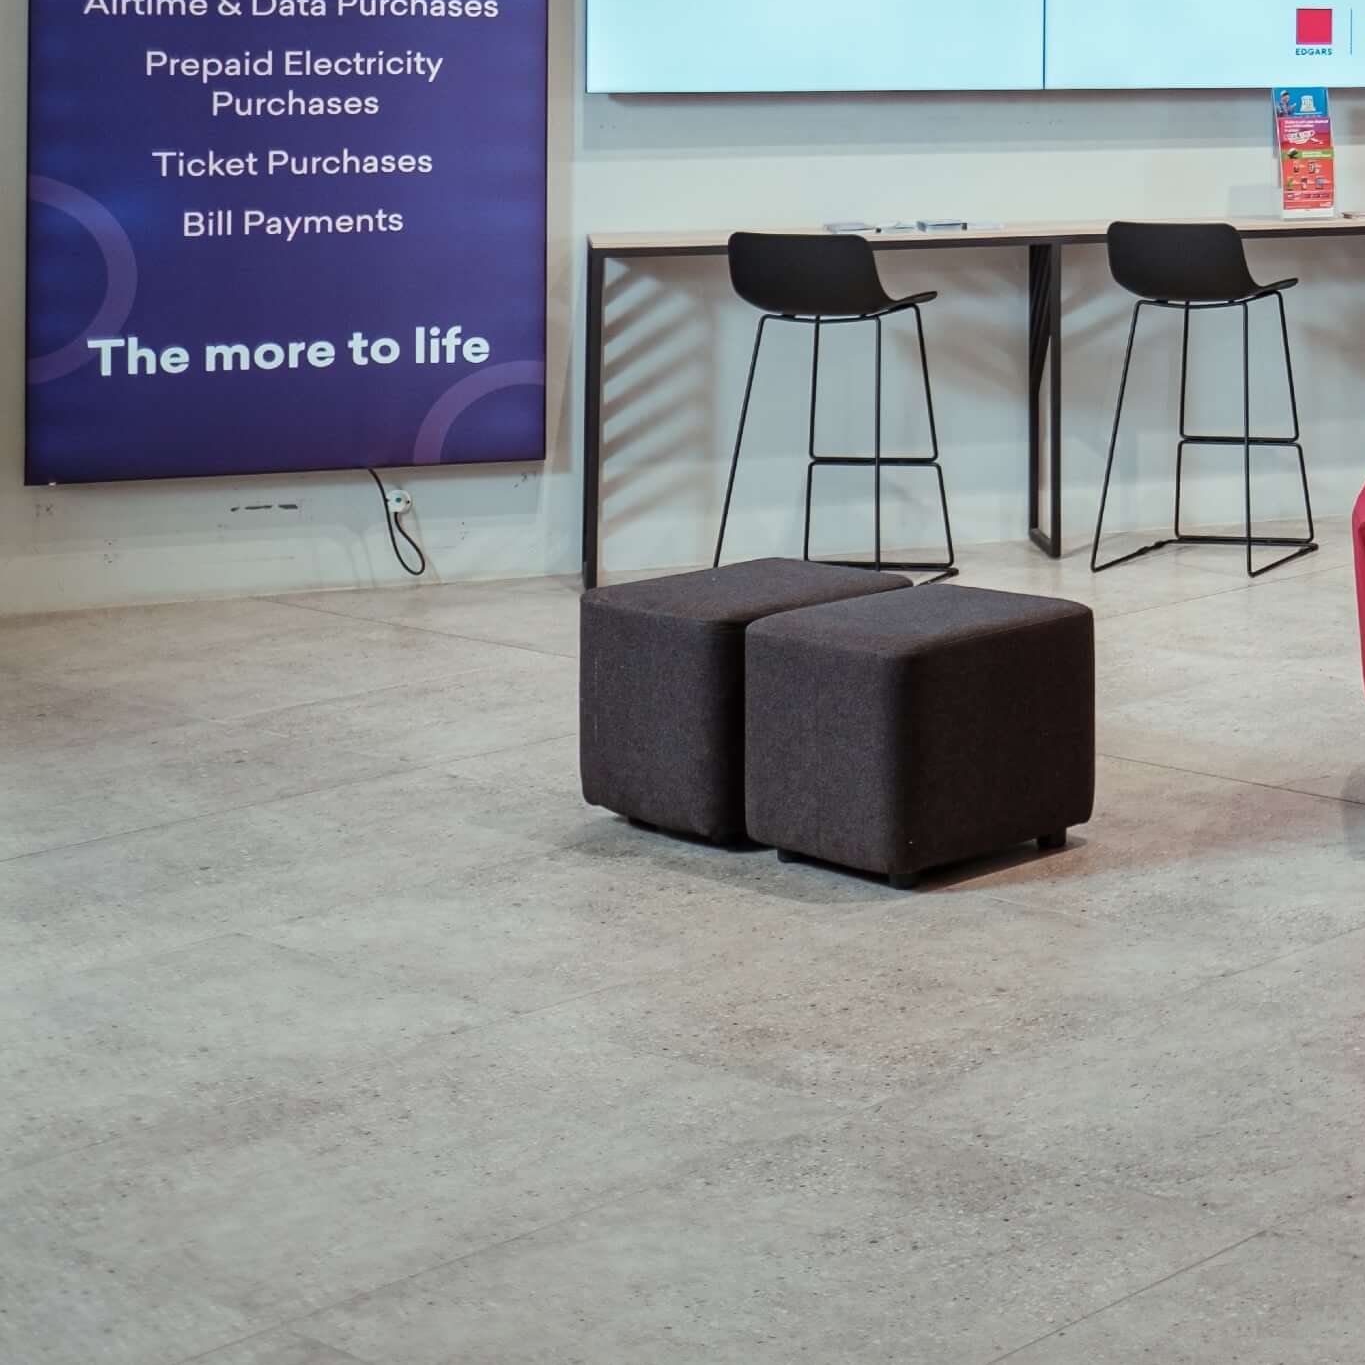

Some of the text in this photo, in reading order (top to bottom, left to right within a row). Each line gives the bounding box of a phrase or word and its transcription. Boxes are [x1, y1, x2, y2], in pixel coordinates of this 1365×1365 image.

[1295, 48, 1333, 56] EDGARS
[146, 50, 443, 85] Prepaid Electricity
[212, 90, 380, 116] Purchases
[152, 149, 433, 177] Ticket Purchases
[183, 208, 404, 241] Bill Payments
[88, 325, 491, 376] The more to life
